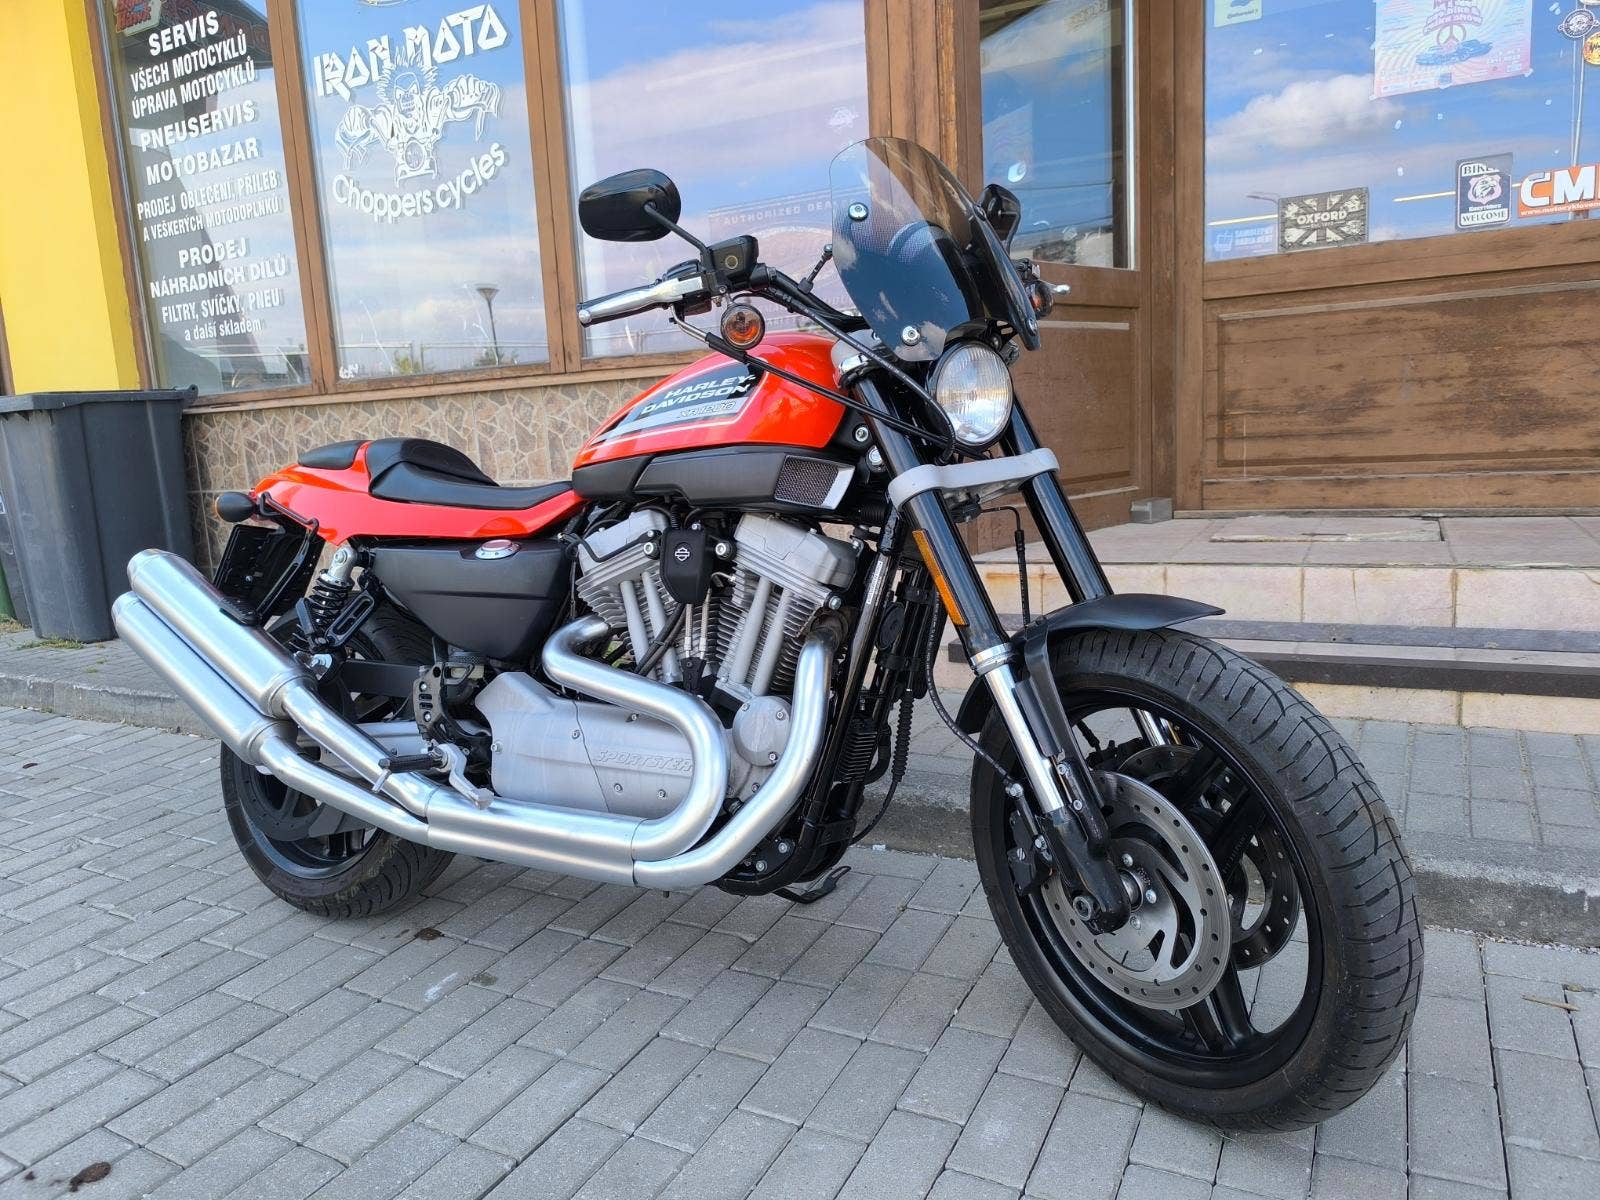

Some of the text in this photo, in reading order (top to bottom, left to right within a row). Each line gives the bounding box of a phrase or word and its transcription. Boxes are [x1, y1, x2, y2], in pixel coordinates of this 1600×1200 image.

[149, 11, 219, 56] SERVIS
[130, 29, 247, 92] VŠECH MOTOCYKLŮ
[131, 56, 255, 119] ÚPRAVA MOTOCYKLŮ
[140, 100, 256, 152] PNEUSERVIS
[145, 137, 259, 186] MOTOBAZAR
[332, 142, 505, 224] Choppers cycles
[1521, 165, 1600, 207] CM
[137, 195, 176, 220] PRODEJ
[723, 206, 800, 225] AUTHORIZED
[1297, 211, 1348, 225] OXFORD
[1462, 210, 1506, 222] WELCOME
[143, 227, 150, 242] A
[151, 213, 204, 240] VEŠKERÝCH
[178, 237, 247, 269] PRODEJ
[150, 267, 246, 298] NÁHRADNÍCH
[161, 303, 199, 323] FILTRY,
[249, 287, 281, 309] PNEU
[184, 319, 262, 341] a další skladem
[641, 384, 751, 415] DAVIDSON
[599, 750, 694, 772] SPORTSTER
